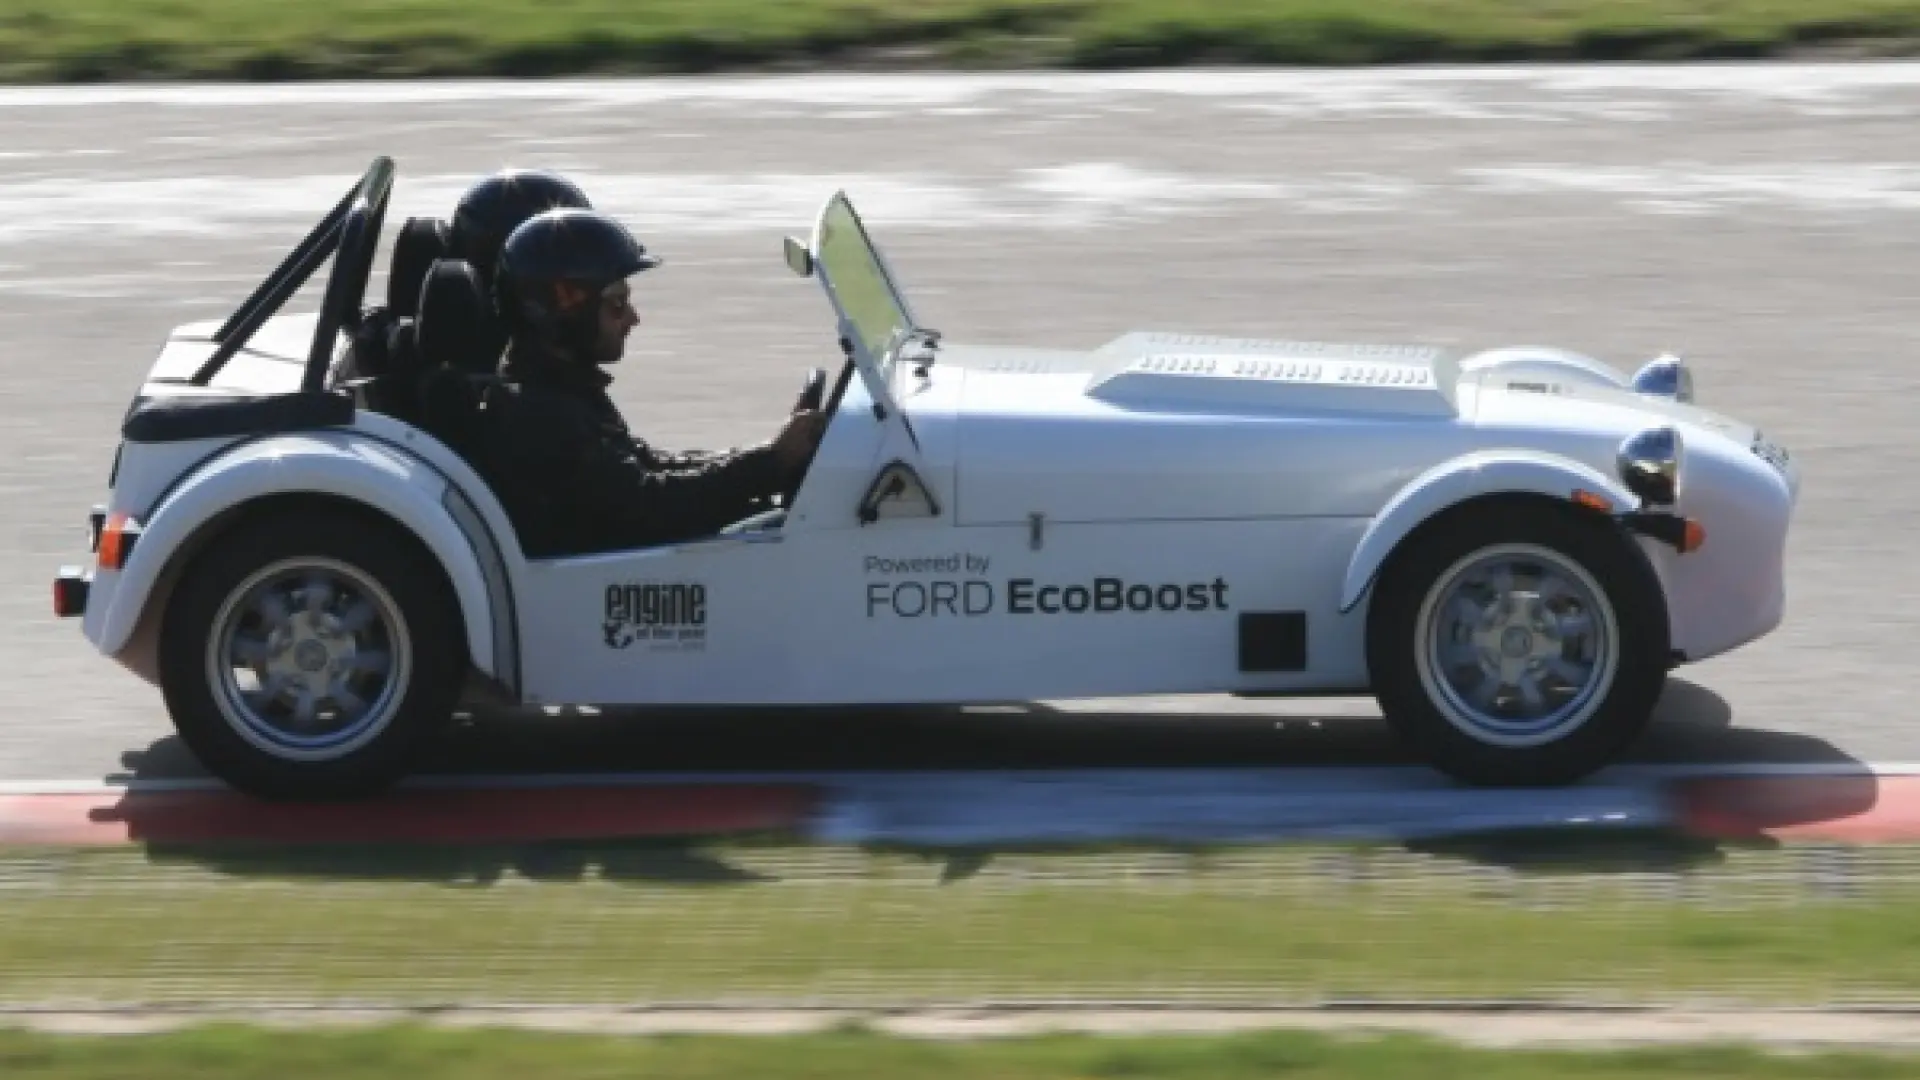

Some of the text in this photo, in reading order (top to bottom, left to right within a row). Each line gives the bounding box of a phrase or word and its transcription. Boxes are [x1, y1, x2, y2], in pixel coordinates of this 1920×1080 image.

[866, 553, 990, 575] Powered by
[605, 584, 705, 625] engine
[866, 577, 1229, 617] FORD EcoBoost
